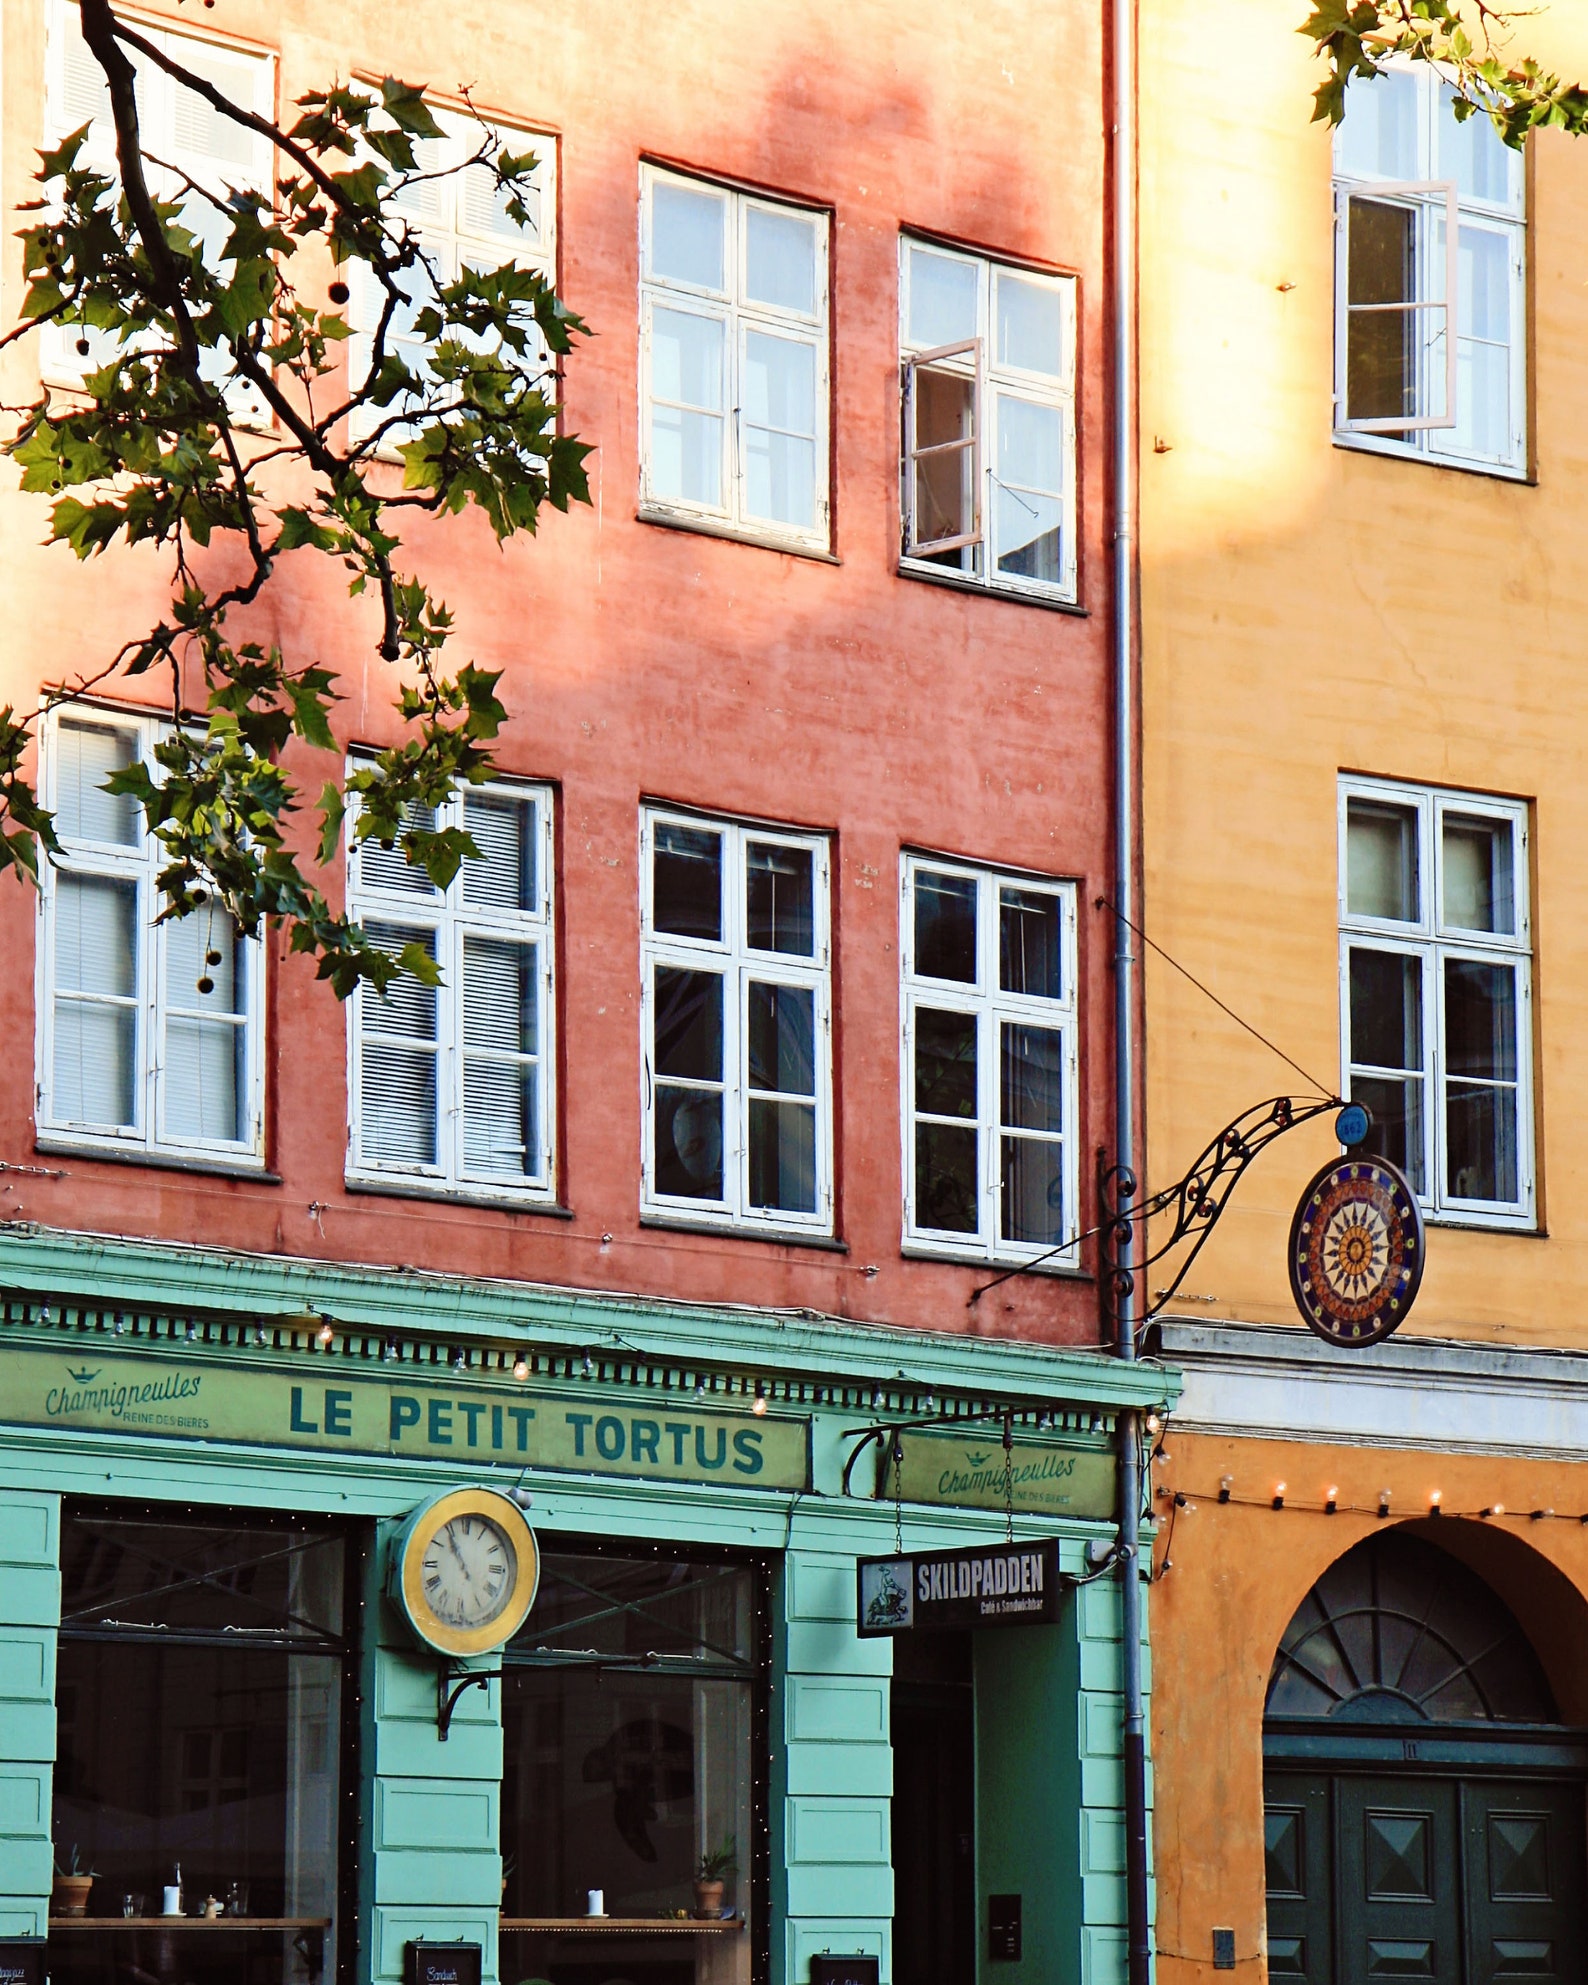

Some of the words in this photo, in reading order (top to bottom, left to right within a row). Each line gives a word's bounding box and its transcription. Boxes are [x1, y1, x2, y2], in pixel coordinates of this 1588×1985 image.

[46, 1372, 201, 1417] Champigneulles
[122, 1411, 154, 1424] REINE
[155, 1414, 177, 1427] DES
[290, 1386, 352, 1437] LE
[389, 1395, 536, 1451] PETIT
[565, 1412, 764, 1475] TORTUS
[938, 1454, 1077, 1494] Champigneulles
[918, 1554, 1043, 1602] SKILDPADDEN
